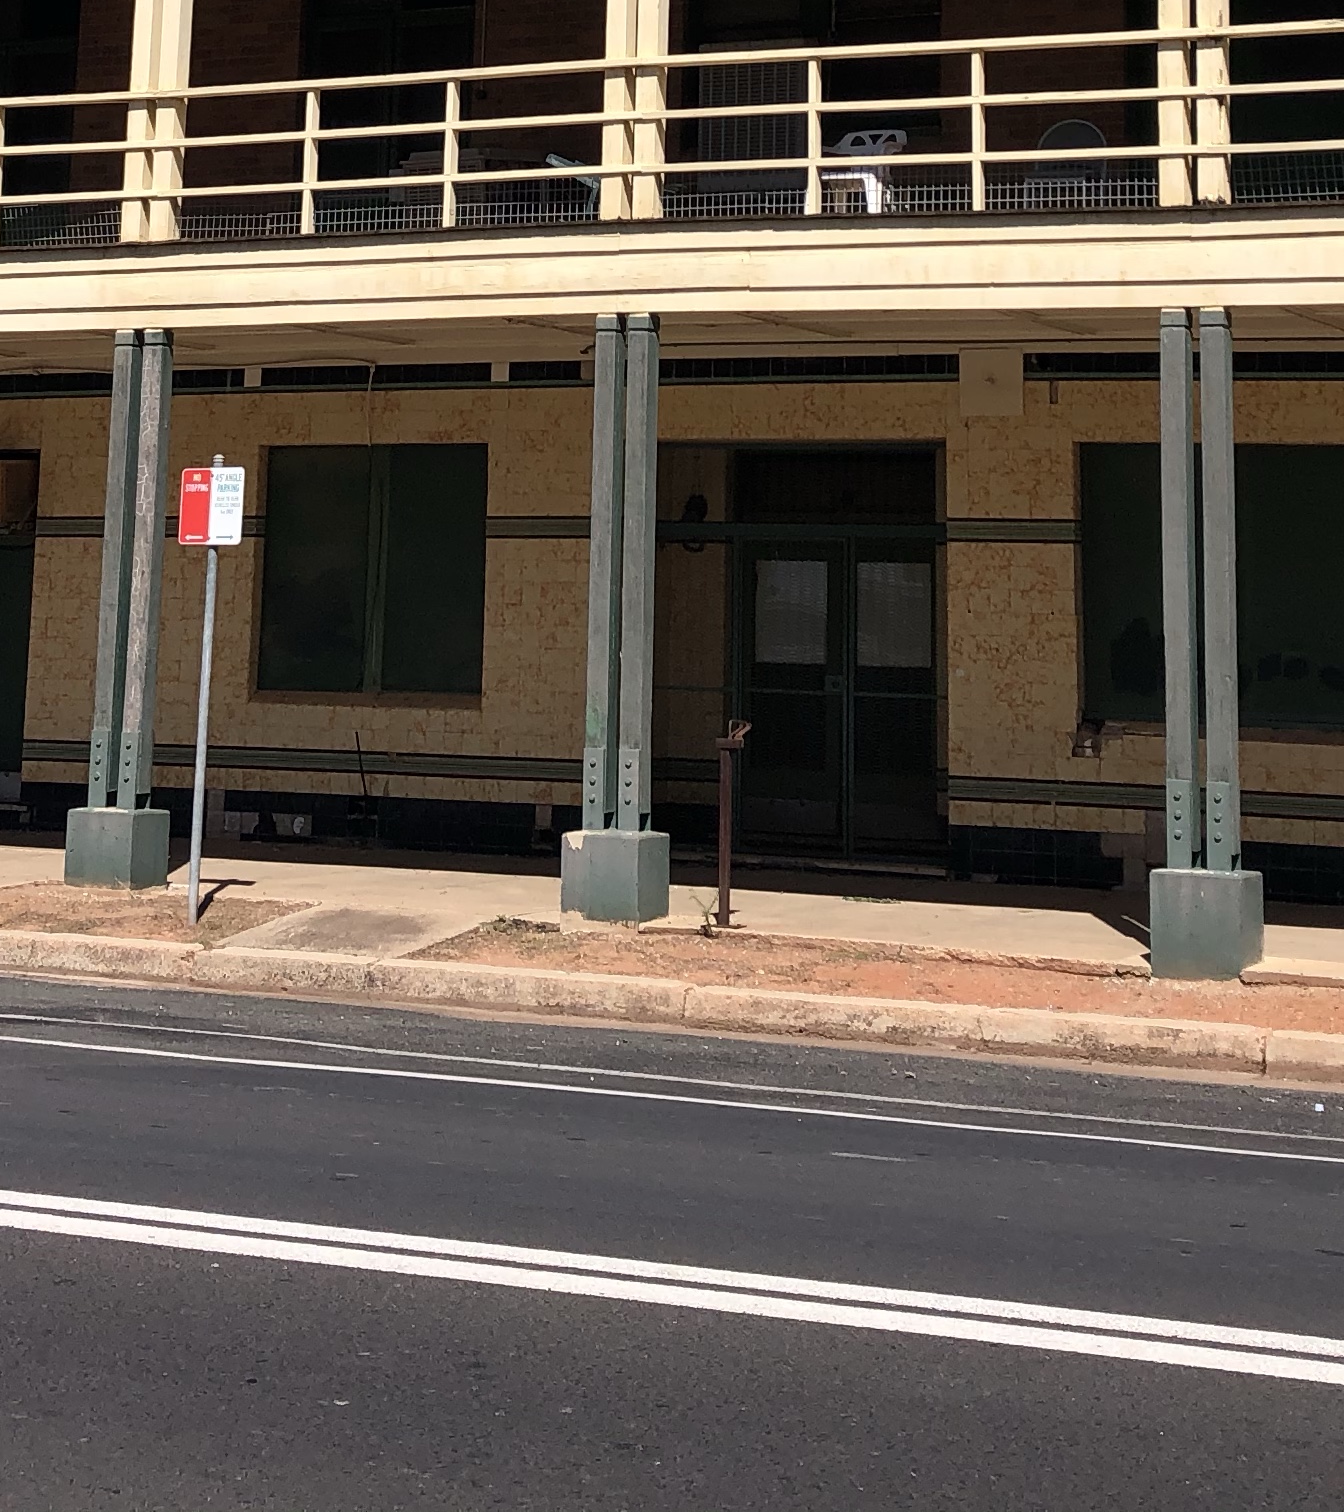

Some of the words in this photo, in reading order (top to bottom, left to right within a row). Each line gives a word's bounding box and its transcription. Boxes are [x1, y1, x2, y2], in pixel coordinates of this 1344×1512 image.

[193, 473, 201, 482] NO
[225, 473, 242, 481] ANGLE
[185, 483, 208, 492] STOPPING
[217, 484, 239, 492] PARKING
